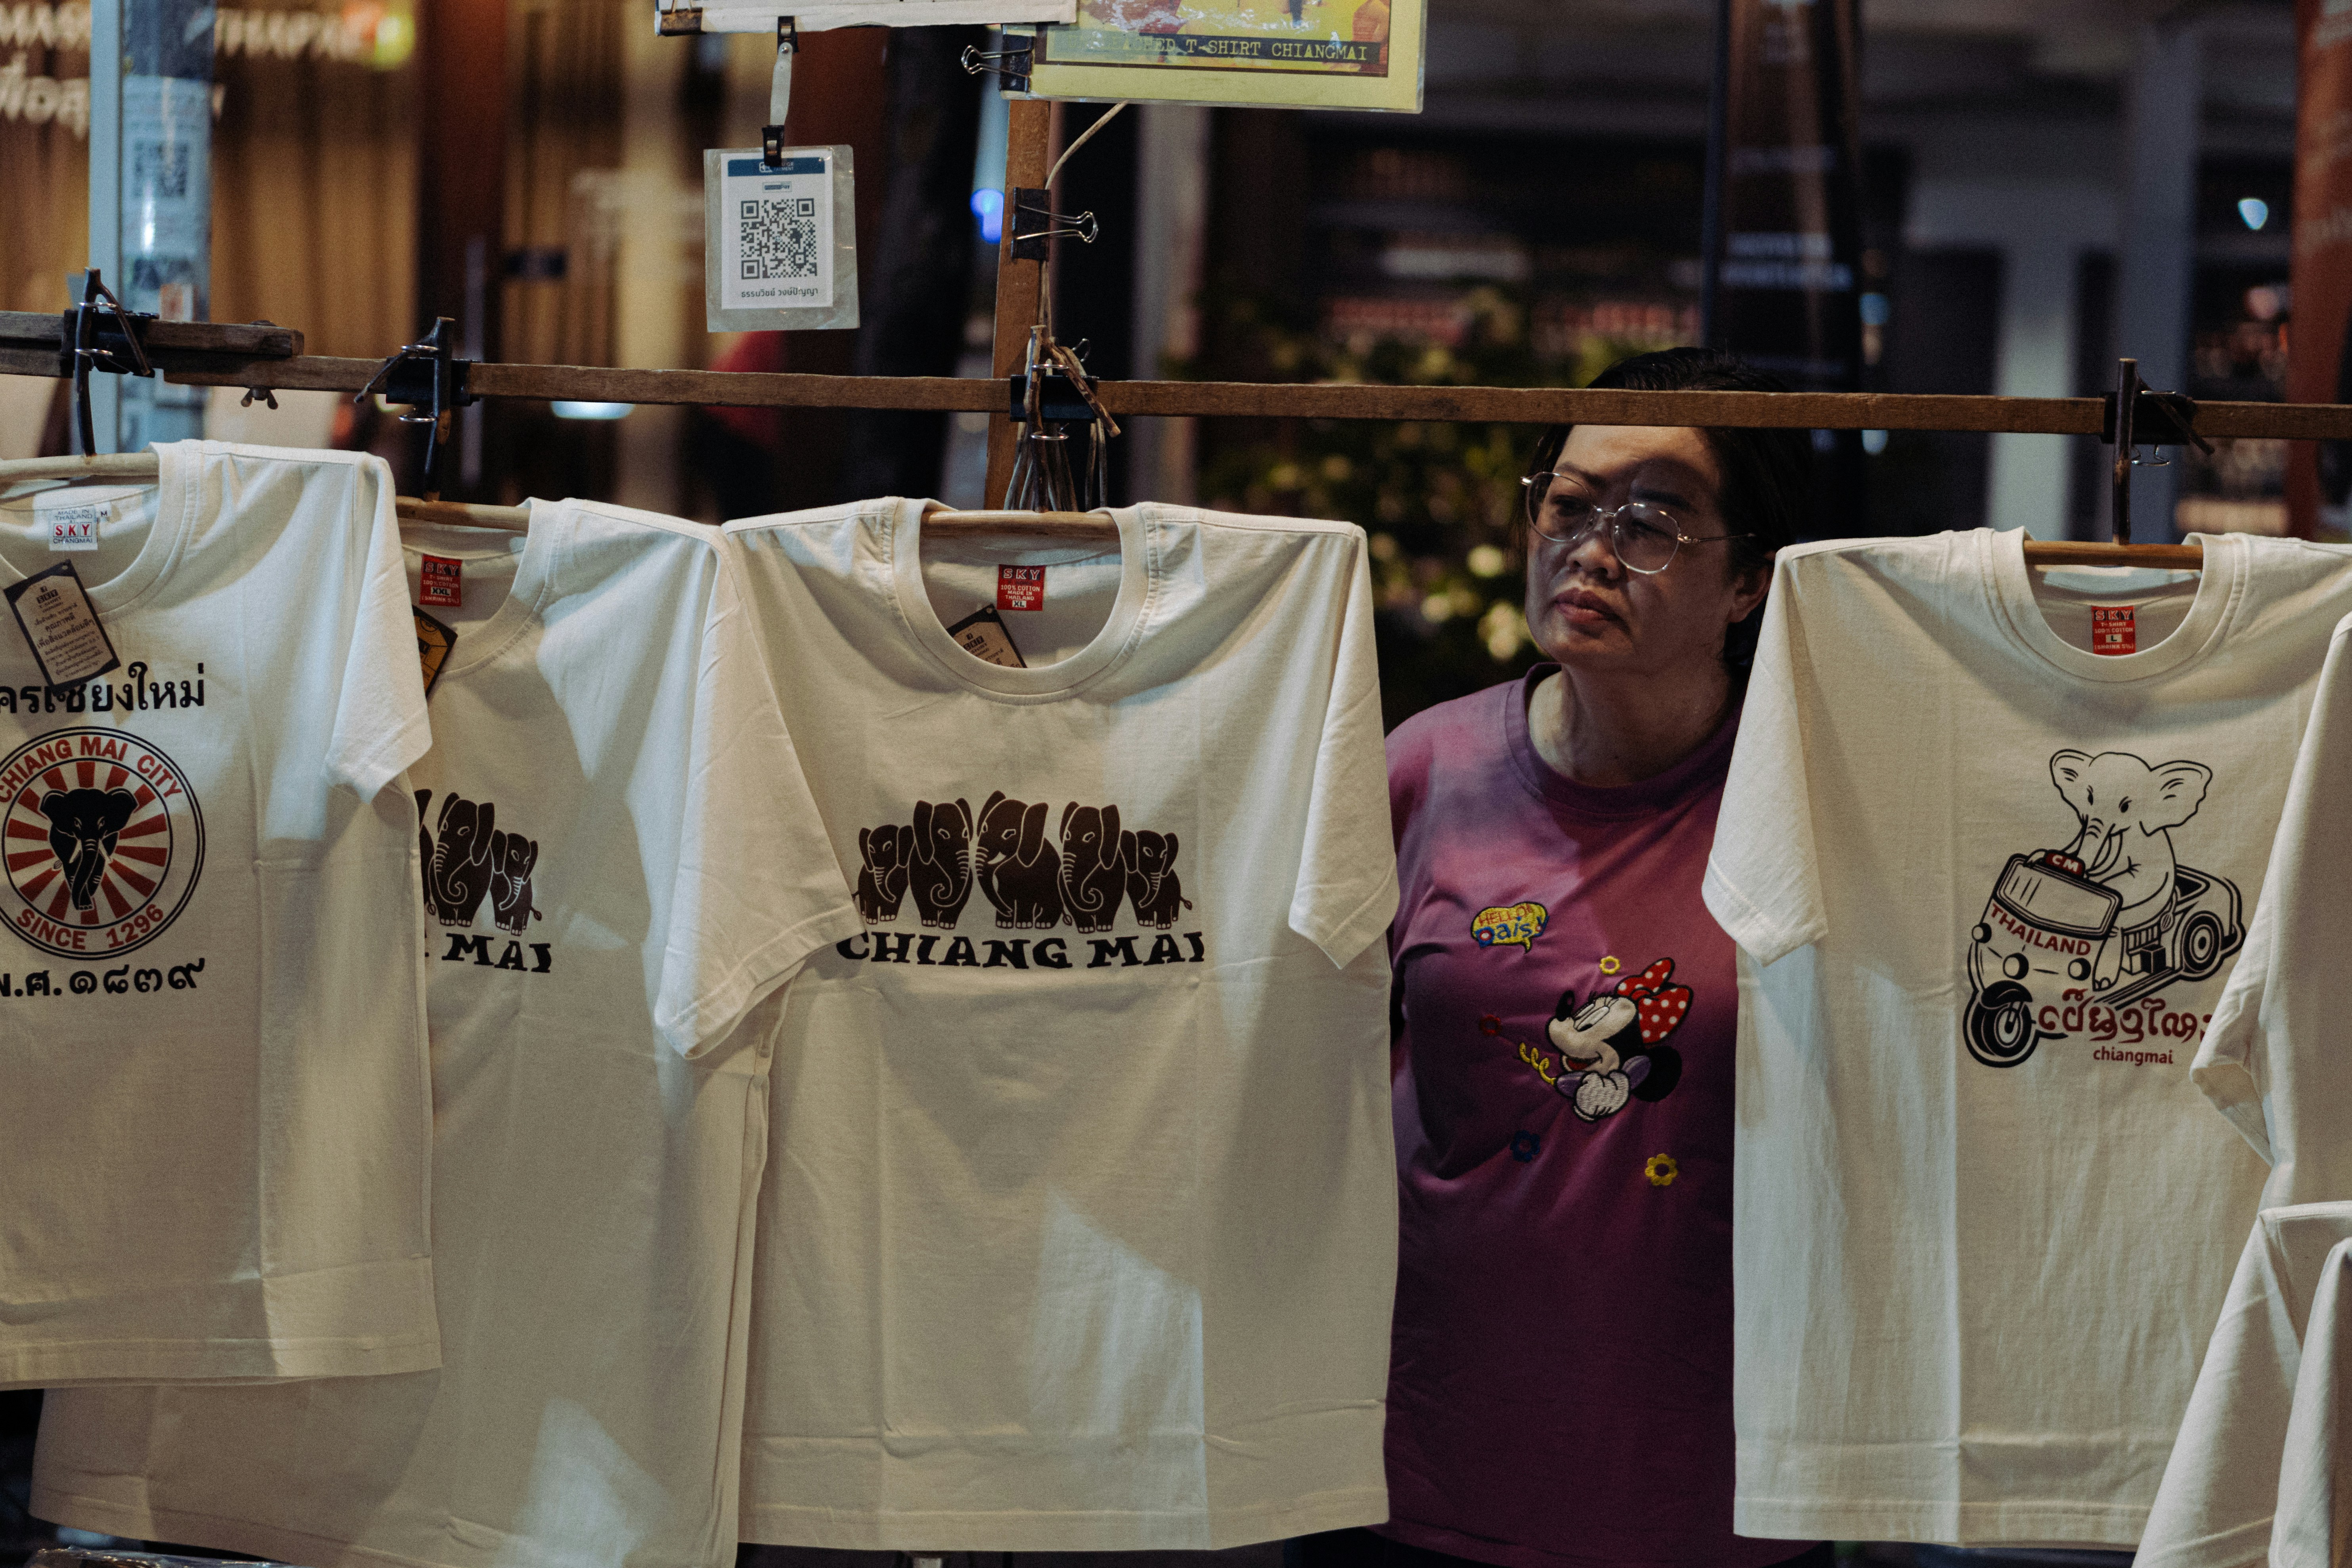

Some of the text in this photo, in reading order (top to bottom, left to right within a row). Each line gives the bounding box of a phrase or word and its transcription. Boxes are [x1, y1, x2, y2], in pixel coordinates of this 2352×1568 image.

[1186, 38, 1261, 56] T-SHIRT
[1271, 42, 1367, 61] CHIANGMAI
[55, 524, 90, 535] SKY
[425, 562, 459, 576] SKY
[1004, 568, 1040, 580] SKY
[2095, 610, 2132, 620] SKY
[0, 736, 182, 803] CHIANG MAI CITY
[2052, 855, 2079, 872] CM
[17, 904, 164, 950] SINCE 1296
[1991, 903, 2091, 956] THAILAND
[442, 933, 552, 973] MAI
[836, 931, 1205, 969] CHIANG MAI
[2093, 1046, 2174, 1066] chiangmai
